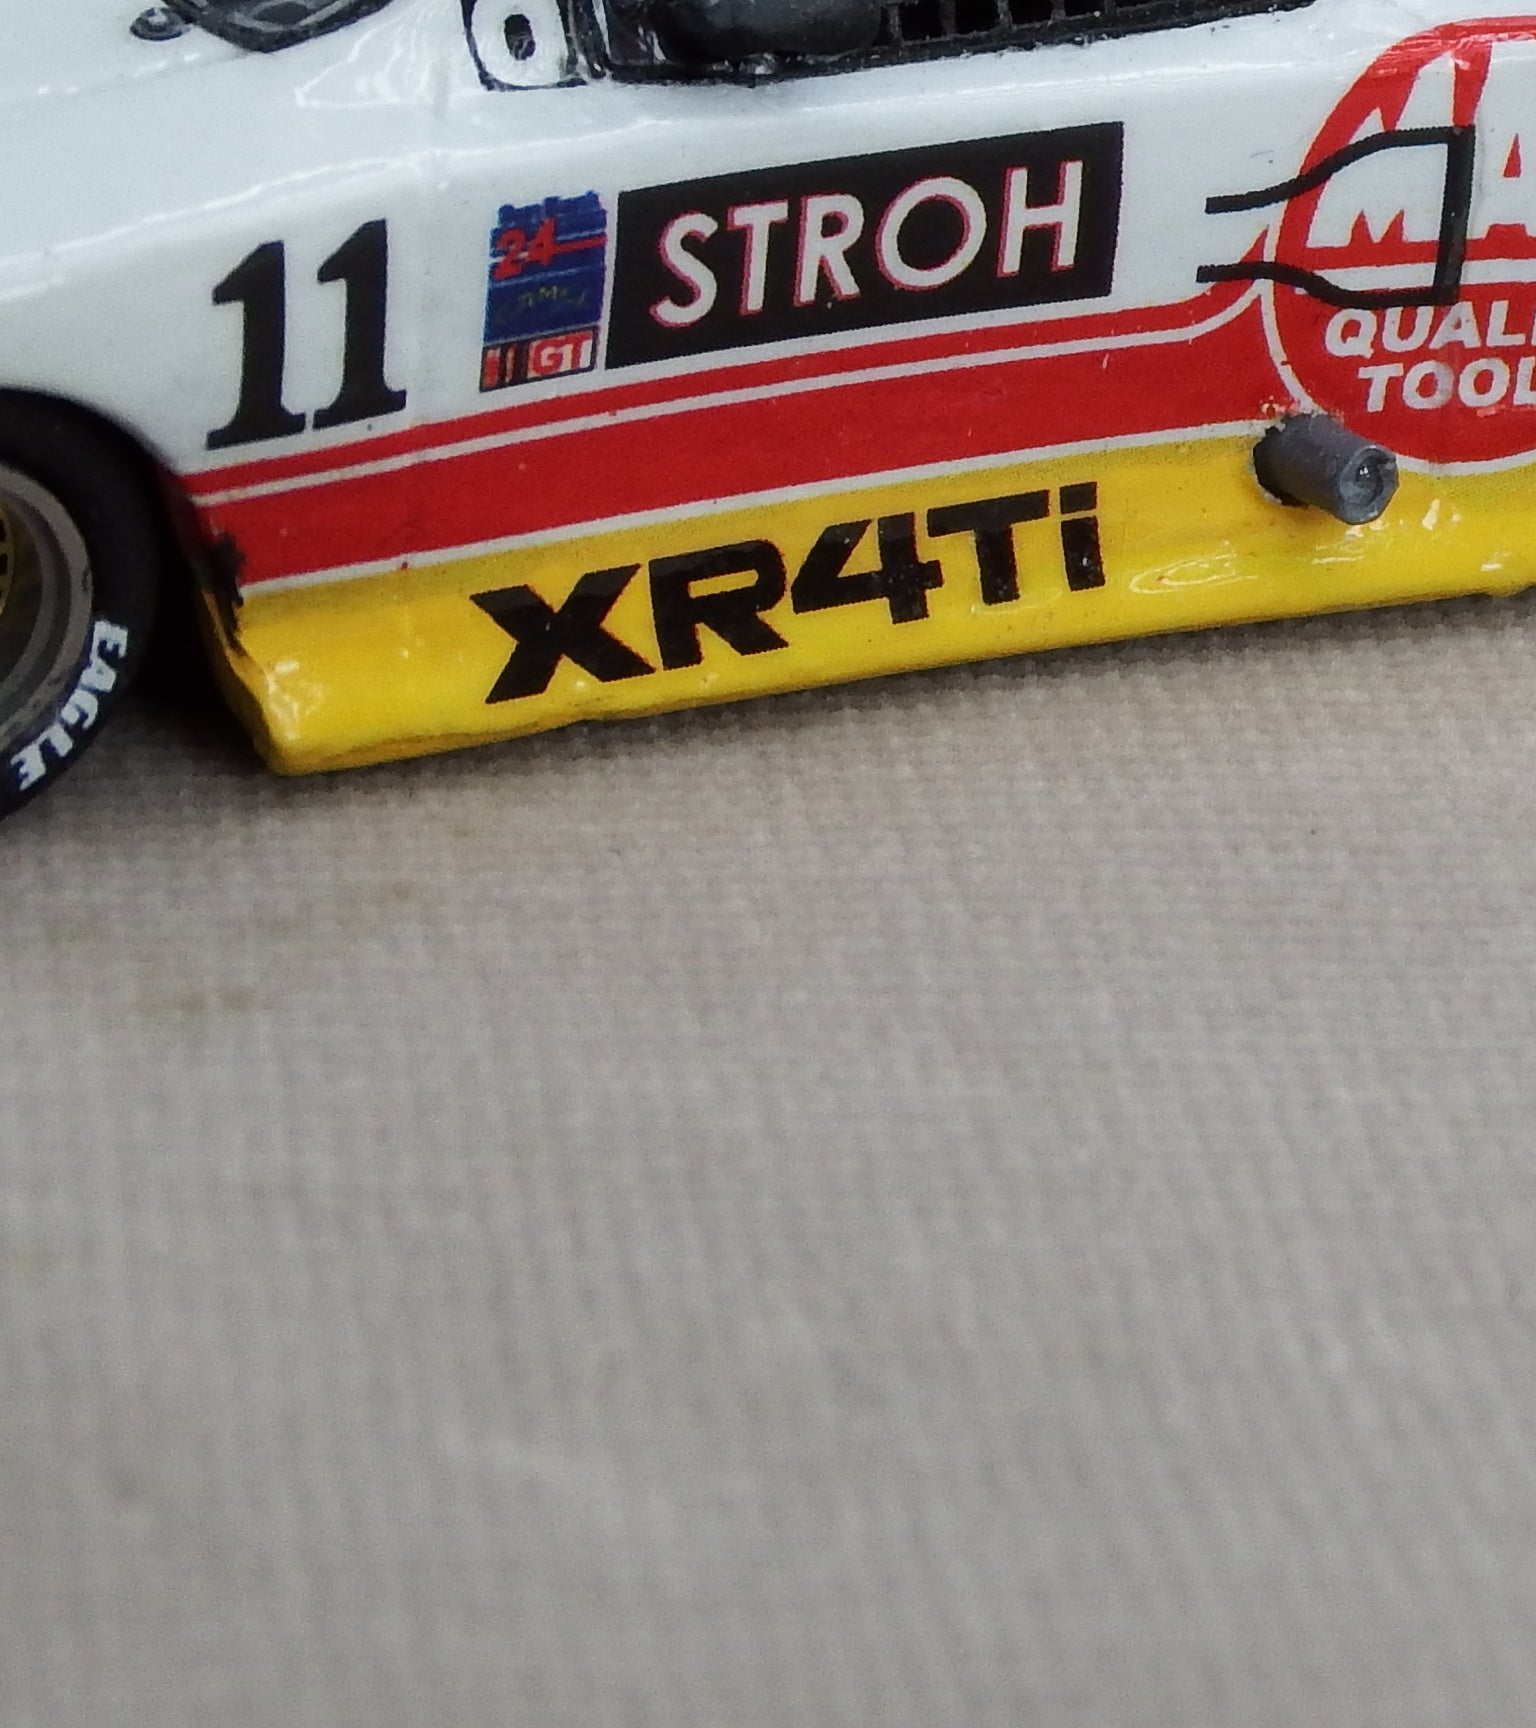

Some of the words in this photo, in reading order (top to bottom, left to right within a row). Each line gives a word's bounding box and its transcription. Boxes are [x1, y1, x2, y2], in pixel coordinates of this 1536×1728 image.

[650, 160, 1084, 328] STROH
[204, 217, 408, 451] 11
[530, 329, 594, 378] GT
[469, 481, 1106, 705] XR4Ti
[9, 619, 129, 792] EAGLE
